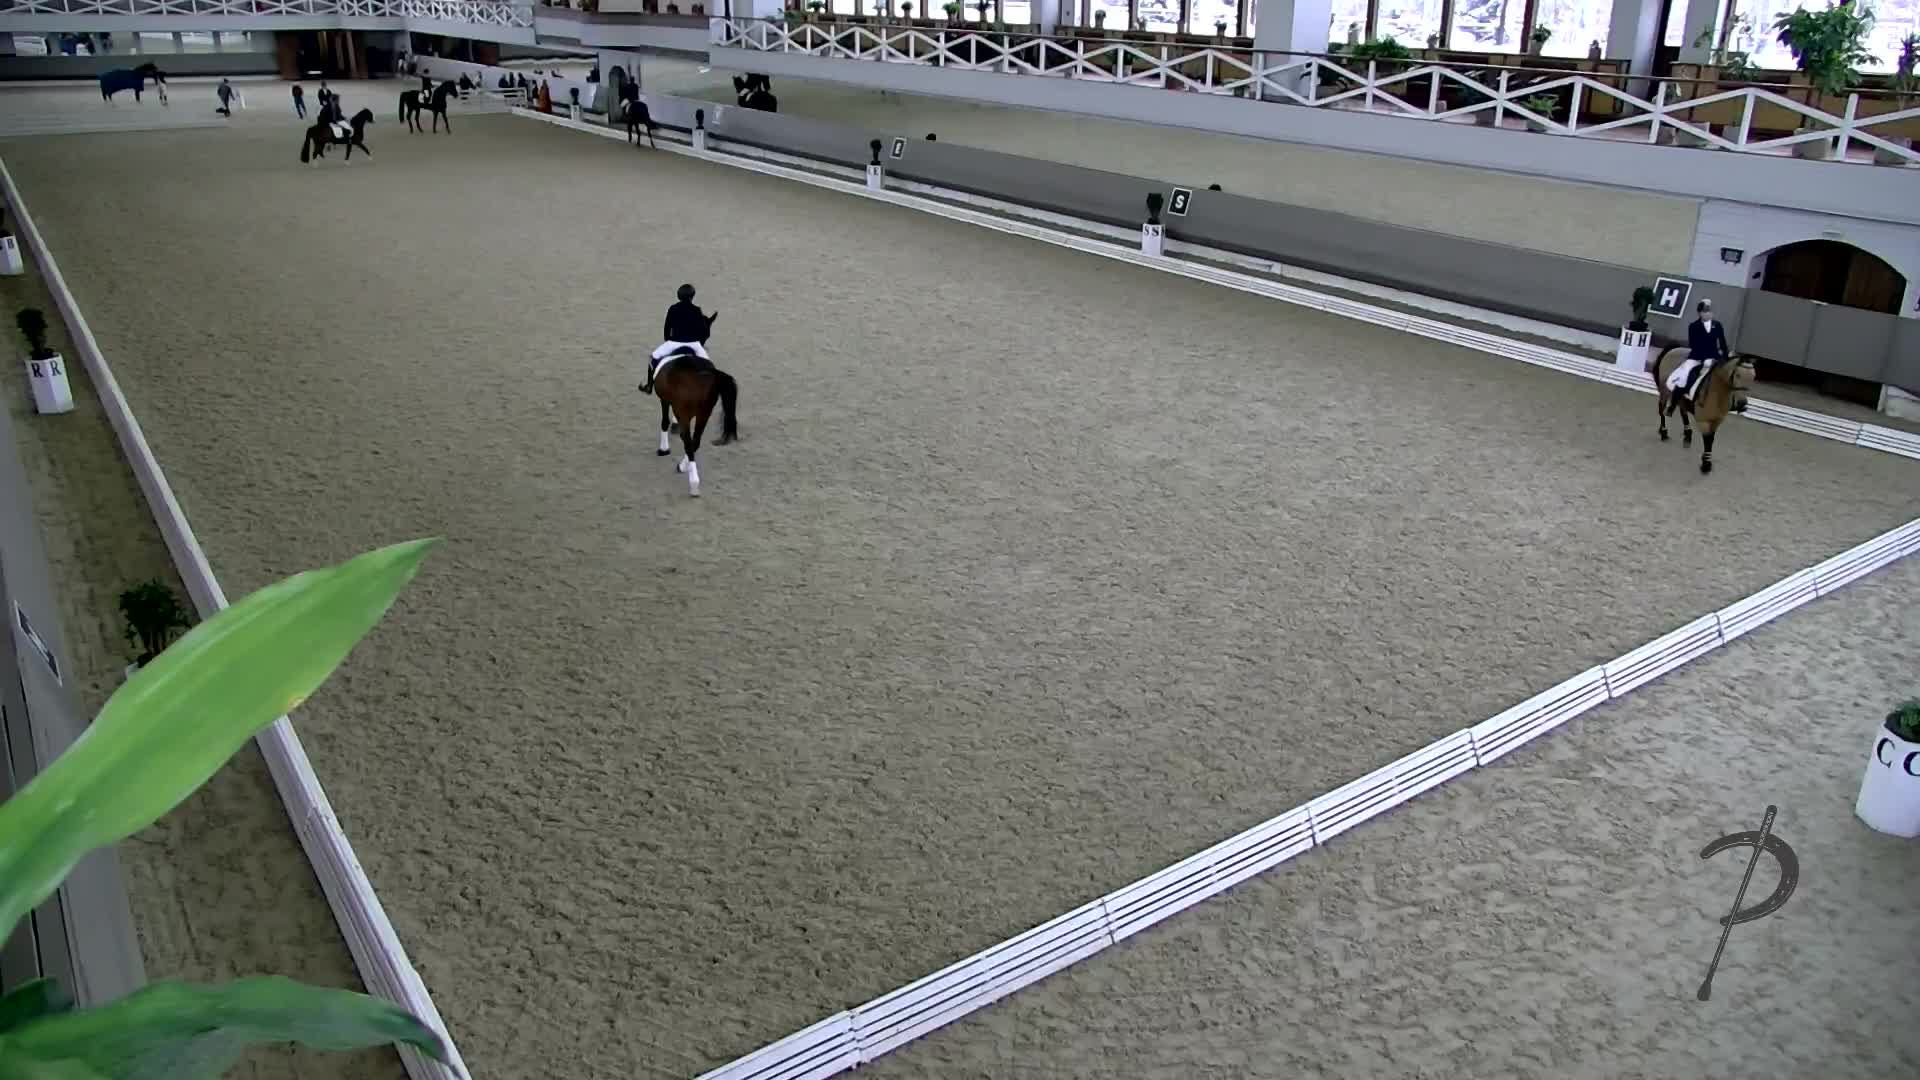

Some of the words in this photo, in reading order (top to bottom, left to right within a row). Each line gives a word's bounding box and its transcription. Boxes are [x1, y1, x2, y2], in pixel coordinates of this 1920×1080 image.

[1175, 194, 1185, 208] S
[1151, 226, 1159, 236] S
[1660, 287, 1679, 308] H
[1623, 331, 1633, 346] H
[1638, 332, 1647, 347] H
[31, 362, 44, 378] R
[49, 360, 62, 376] R
[1876, 737, 1896, 768] C
